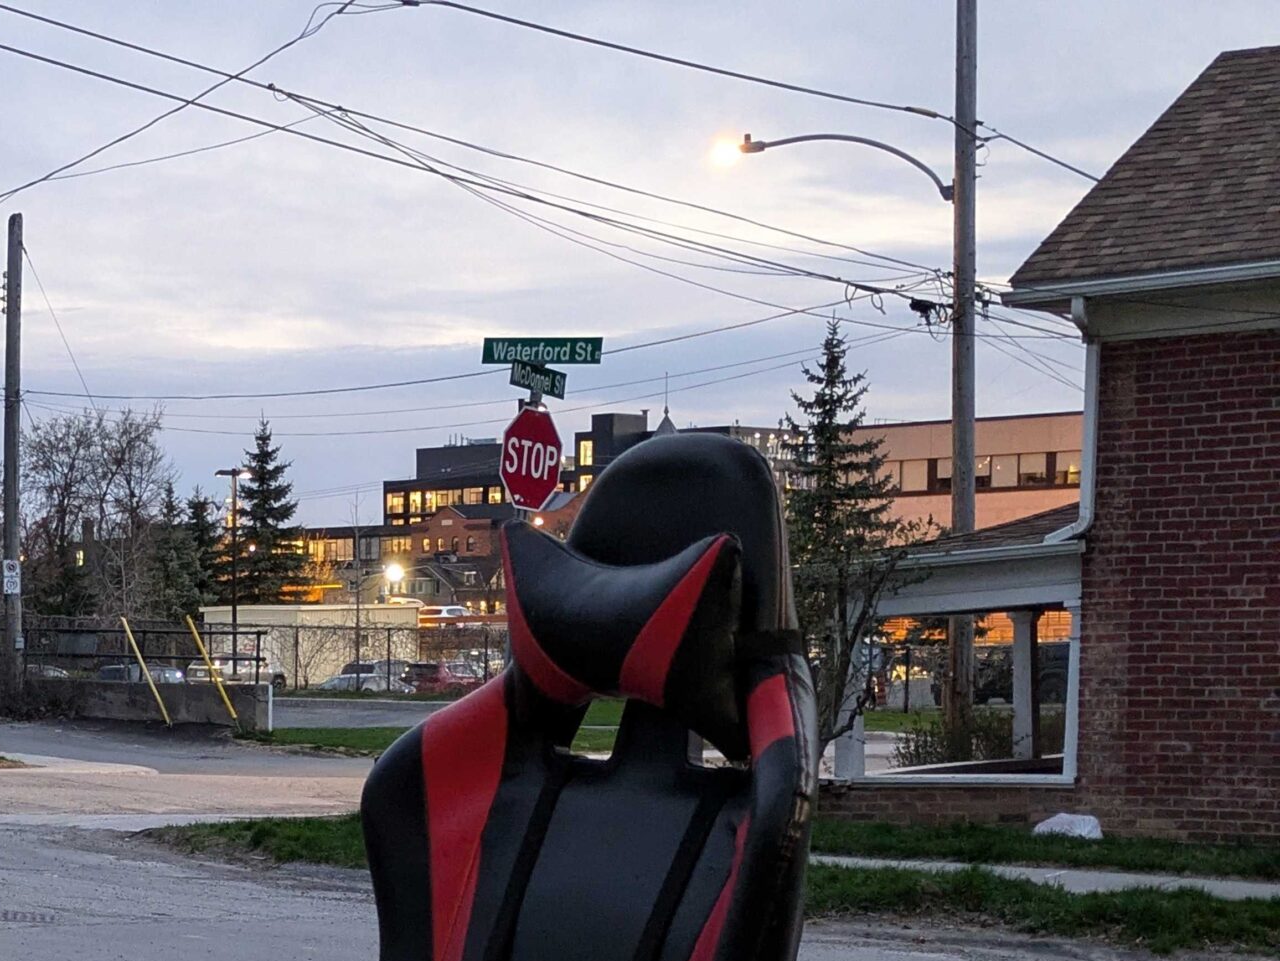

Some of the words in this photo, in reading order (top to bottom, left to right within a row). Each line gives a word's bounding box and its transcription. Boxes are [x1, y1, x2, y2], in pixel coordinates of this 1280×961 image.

[493, 342, 571, 361] Waterford
[575, 341, 592, 361] St
[513, 362, 552, 392] McDonnel
[554, 375, 564, 395] St
[505, 436, 557, 480] STOP
